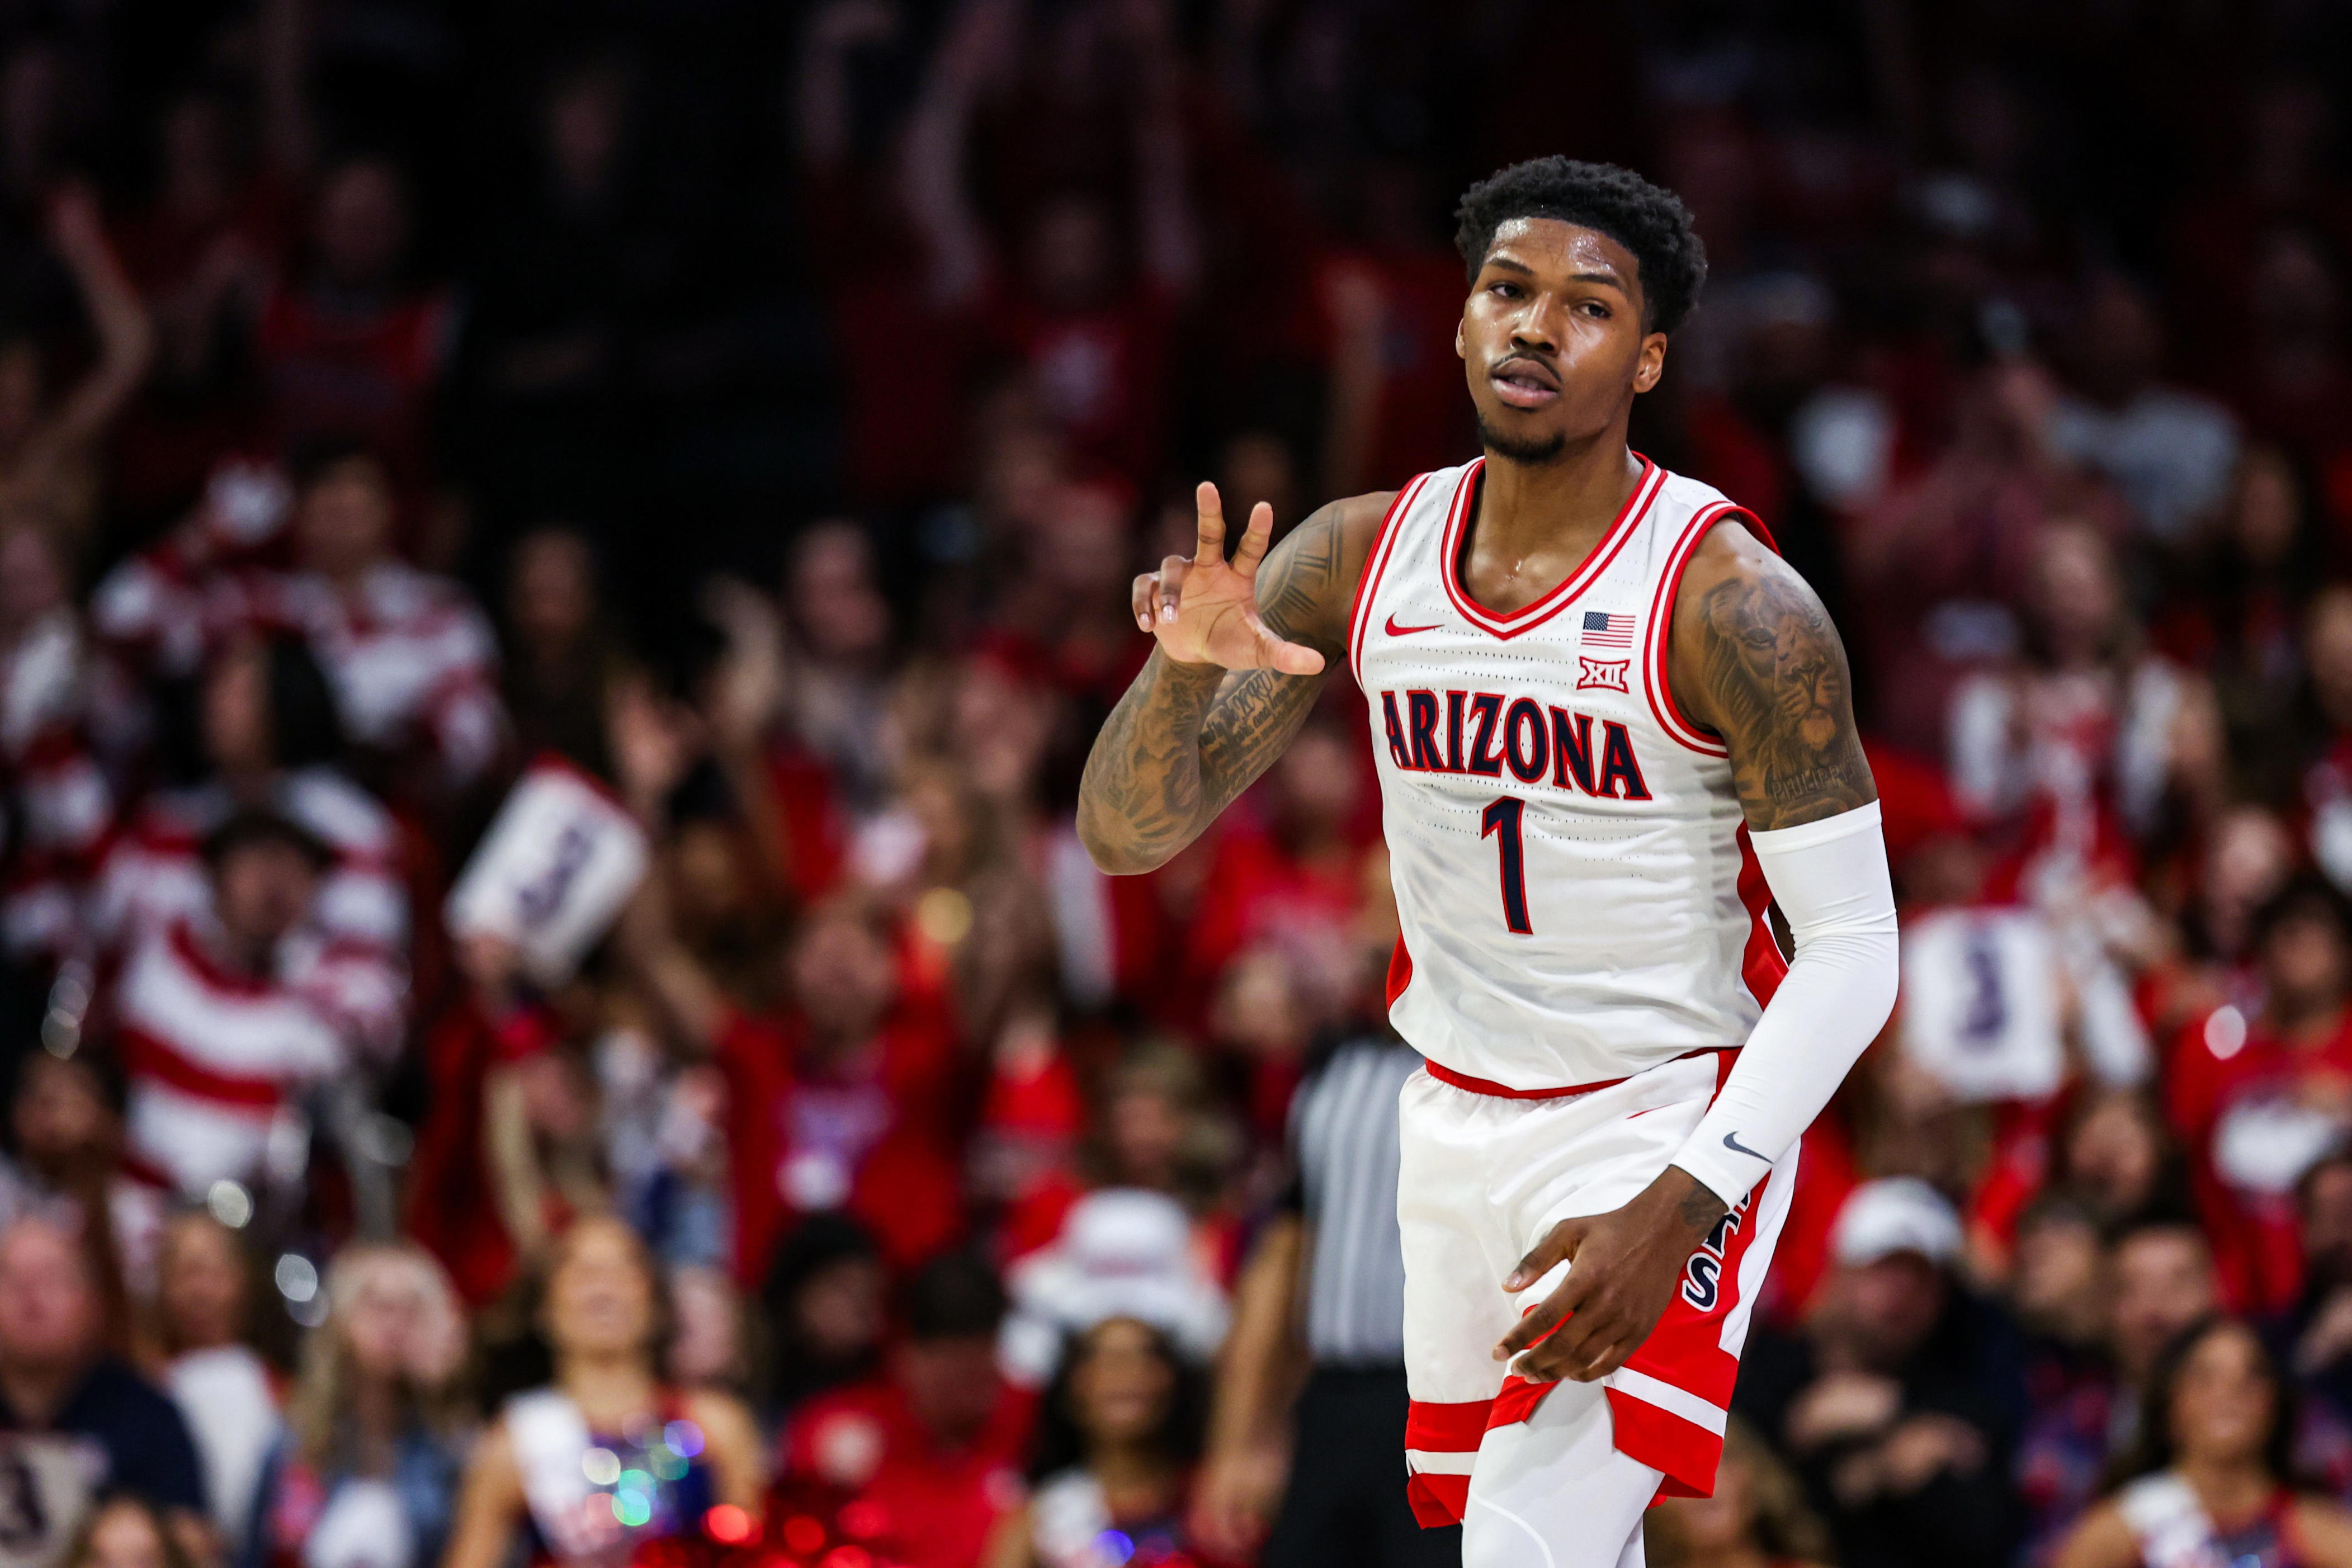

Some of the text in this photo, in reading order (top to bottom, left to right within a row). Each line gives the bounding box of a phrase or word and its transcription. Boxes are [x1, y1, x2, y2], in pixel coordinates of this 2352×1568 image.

[1578, 657, 1630, 693] XII
[1381, 689, 1652, 800] ARIZONA
[1482, 796, 1533, 935] 1
